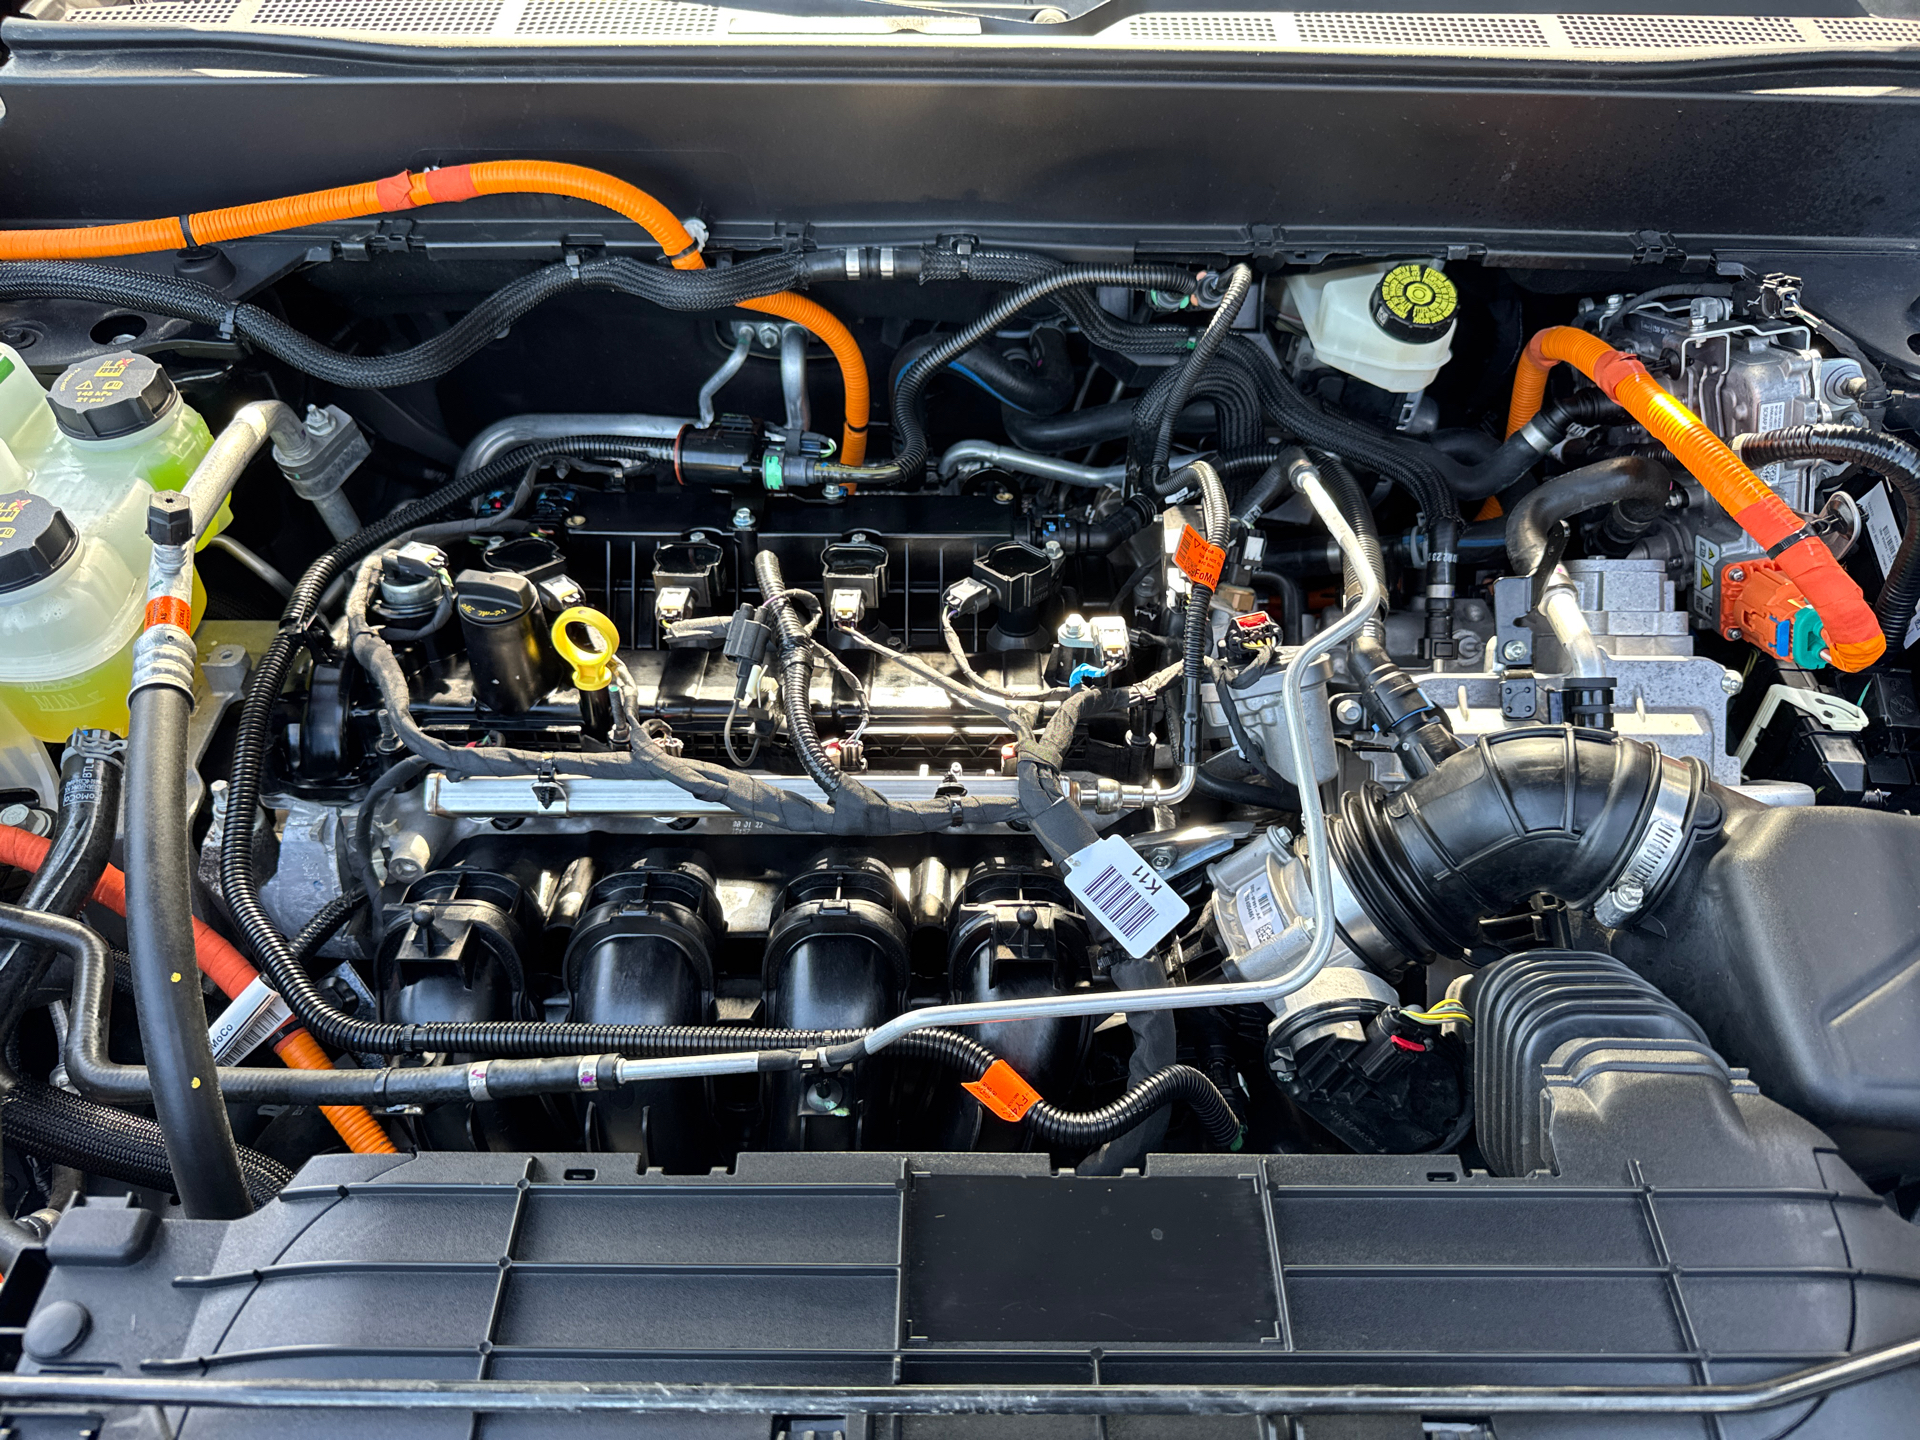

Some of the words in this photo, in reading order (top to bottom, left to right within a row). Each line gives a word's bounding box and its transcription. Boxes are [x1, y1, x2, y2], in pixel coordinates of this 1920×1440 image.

[1193, 569, 1218, 588] FoMo
[31, 692, 80, 711] MIN
[1132, 865, 1162, 896] K11
